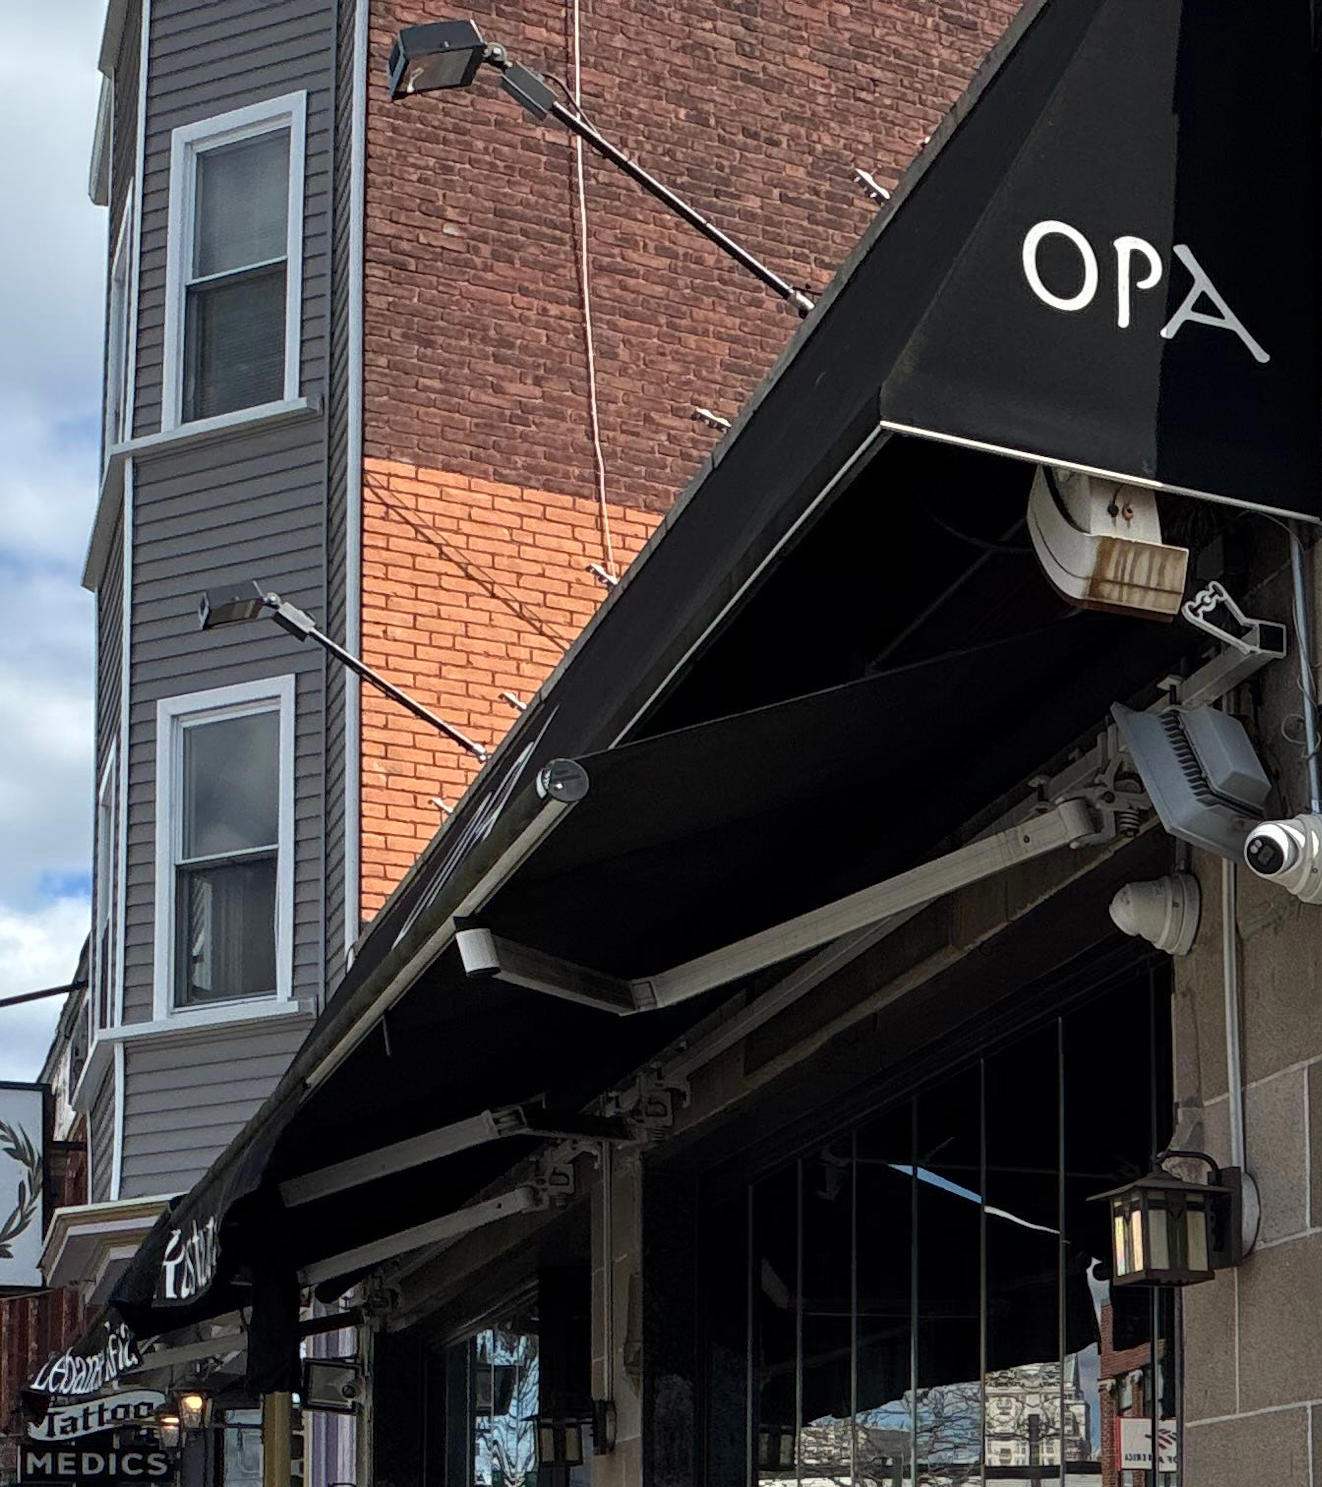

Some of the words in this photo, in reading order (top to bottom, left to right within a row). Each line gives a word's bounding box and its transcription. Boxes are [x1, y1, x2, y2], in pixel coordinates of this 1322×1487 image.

[1022, 219, 1271, 364] OPA
[45, 1401, 154, 1438] Tattoo
[26, 1450, 168, 1477] MEDICS
